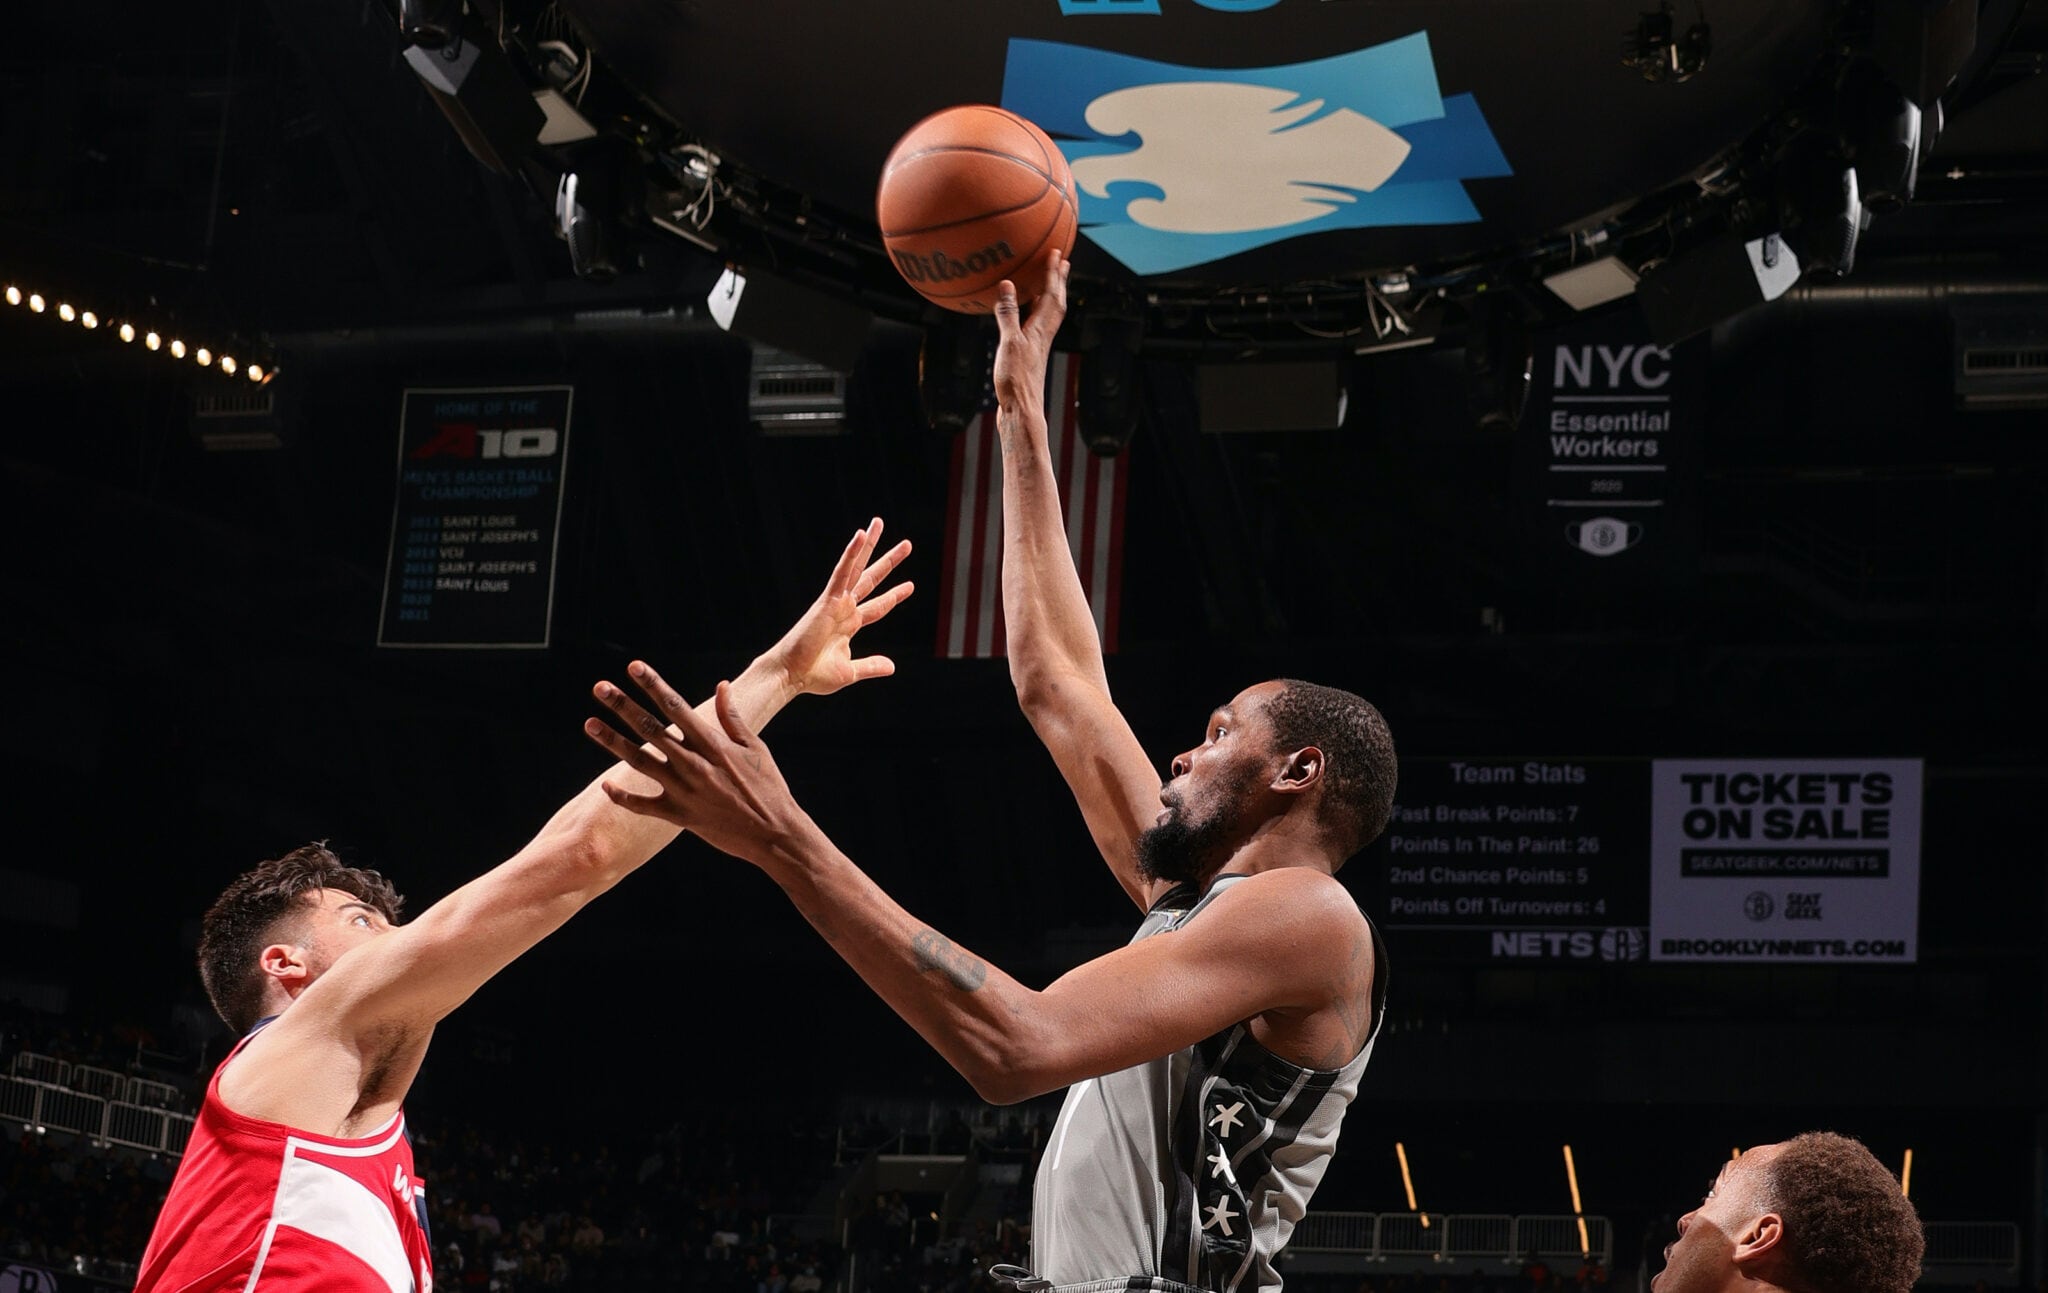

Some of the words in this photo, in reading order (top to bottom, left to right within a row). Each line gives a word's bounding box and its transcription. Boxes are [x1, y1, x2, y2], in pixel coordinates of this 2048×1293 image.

[891, 240, 1015, 282] Wilson
[1553, 344, 1672, 389] NYC
[435, 402, 479, 416] HOME
[484, 401, 504, 415] OF
[509, 401, 538, 414] THE
[1551, 410, 1671, 432] Essential
[411, 423, 558, 459] A10
[1550, 436, 1659, 457] Workers
[454, 468, 554, 483] BASKETBALL
[421, 485, 538, 501] CHAMPIONSHIP
[442, 515, 478, 528] SAINT
[481, 514, 517, 527] LOUIS
[440, 531, 476, 544] SAINT
[479, 529, 539, 543] JOSEPH'S
[440, 546, 464, 559] VCU
[438, 562, 475, 574] SAINT
[478, 560, 537, 574] JOSEPH'S
[435, 578, 472, 591] SAINT
[474, 579, 510, 592] LOUIS
[1451, 763, 1515, 784] Team
[1523, 762, 1586, 784] Stats
[1682, 773, 1892, 804] TICKETS
[1391, 806, 1430, 823] Fast
[1435, 806, 1491, 823] Break
[1497, 806, 1563, 823] Points:
[1568, 806, 1579, 823] 7
[1684, 810, 1751, 838] ON
[1764, 809, 1889, 838] SALE
[1391, 837, 1449, 854] Points
[1456, 837, 1473, 854] In
[1478, 837, 1514, 854] The
[1518, 837, 1572, 854] Paint:
[1577, 837, 1600, 854] 26
[1690, 855, 1880, 872] SEATGEEK.COM/NETS
[1390, 867, 1425, 884] 2nd
[1430, 867, 1501, 884] Chance
[1506, 867, 1572, 884] Points:
[1577, 867, 1589, 884] 5
[1391, 898, 1449, 915] Points
[1455, 898, 1484, 915] Off
[1489, 898, 1590, 915] Turnovers:
[1594, 898, 1607, 915] 4
[1787, 893, 1822, 907] SEAT
[1785, 906, 1823, 921] GEEK
[1491, 931, 1595, 957] NETS
[1661, 938, 1905, 956] BROOKLYNNETS.COM
